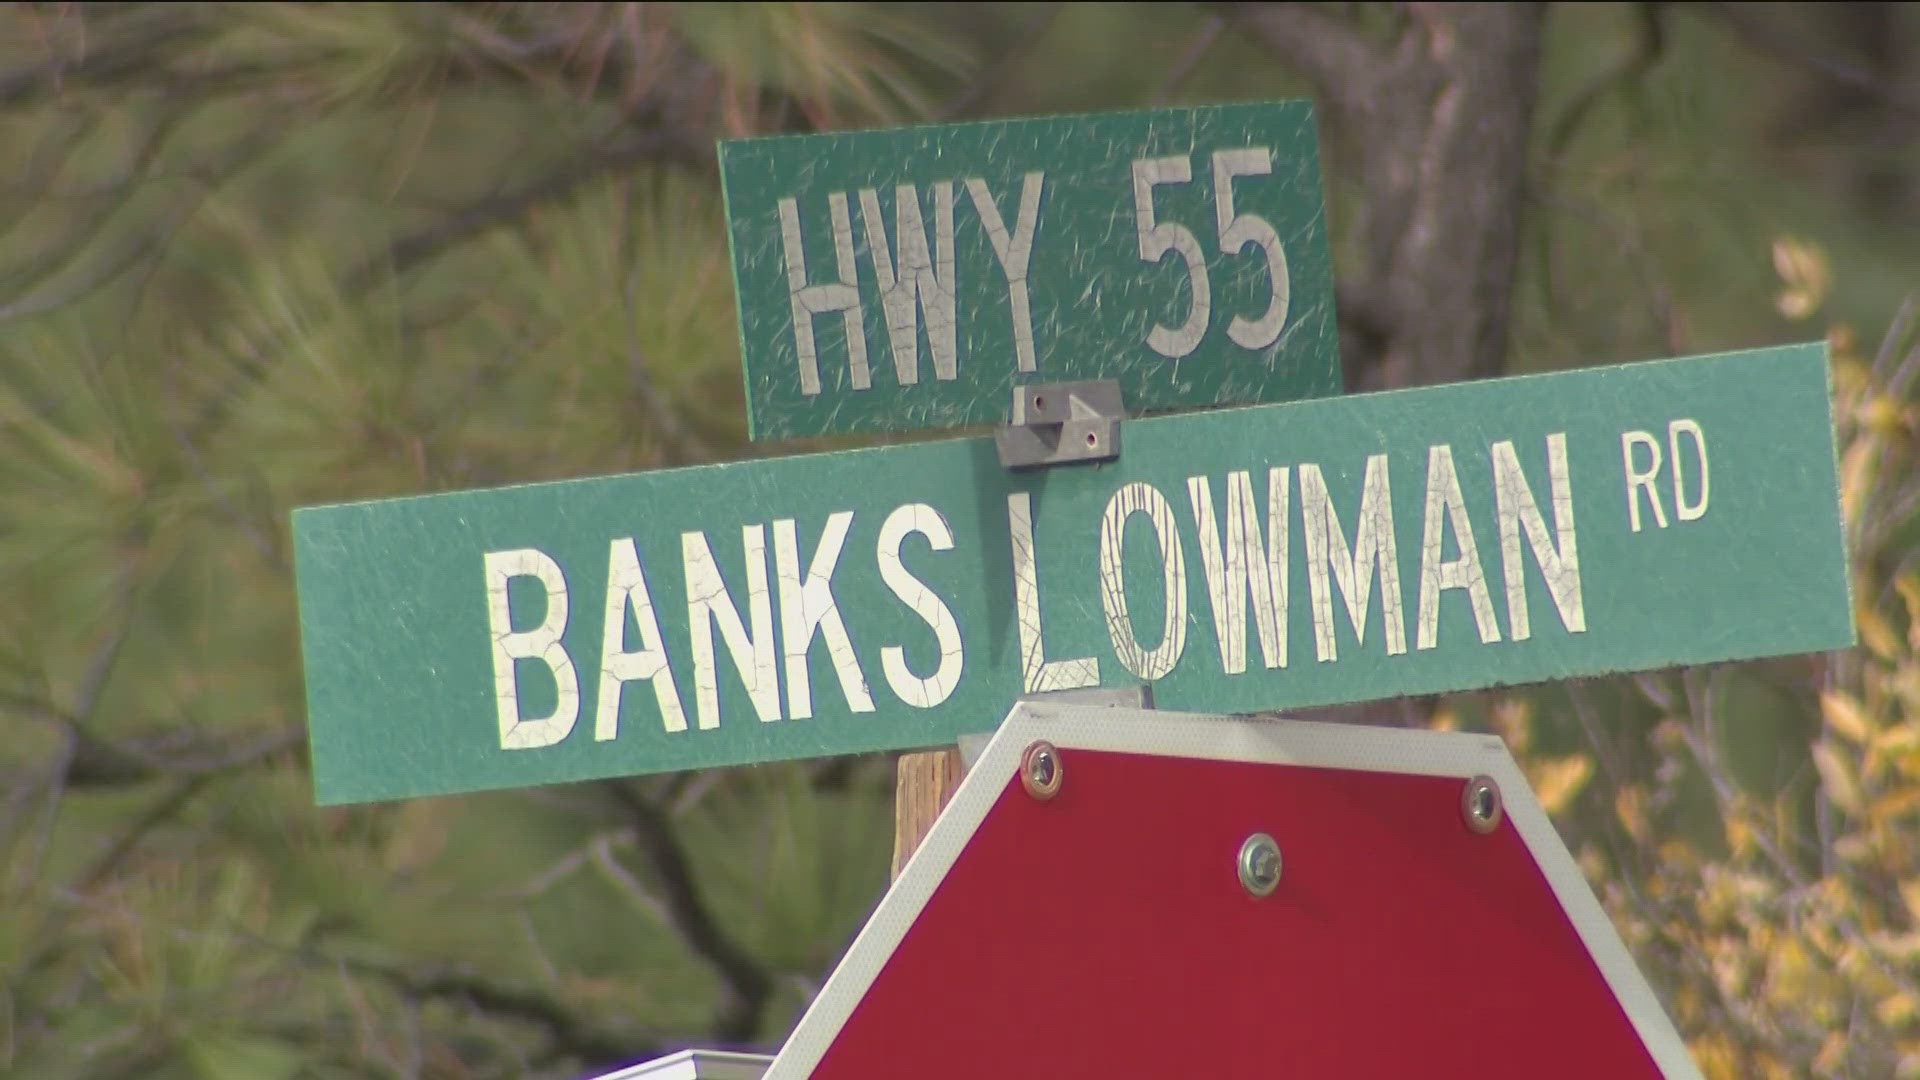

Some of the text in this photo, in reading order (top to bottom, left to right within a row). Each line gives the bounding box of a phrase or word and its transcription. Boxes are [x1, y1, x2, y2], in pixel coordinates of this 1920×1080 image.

[778, 146, 1290, 395] HWY 55
[483, 418, 1711, 751] BANKS LOWMAN RD
